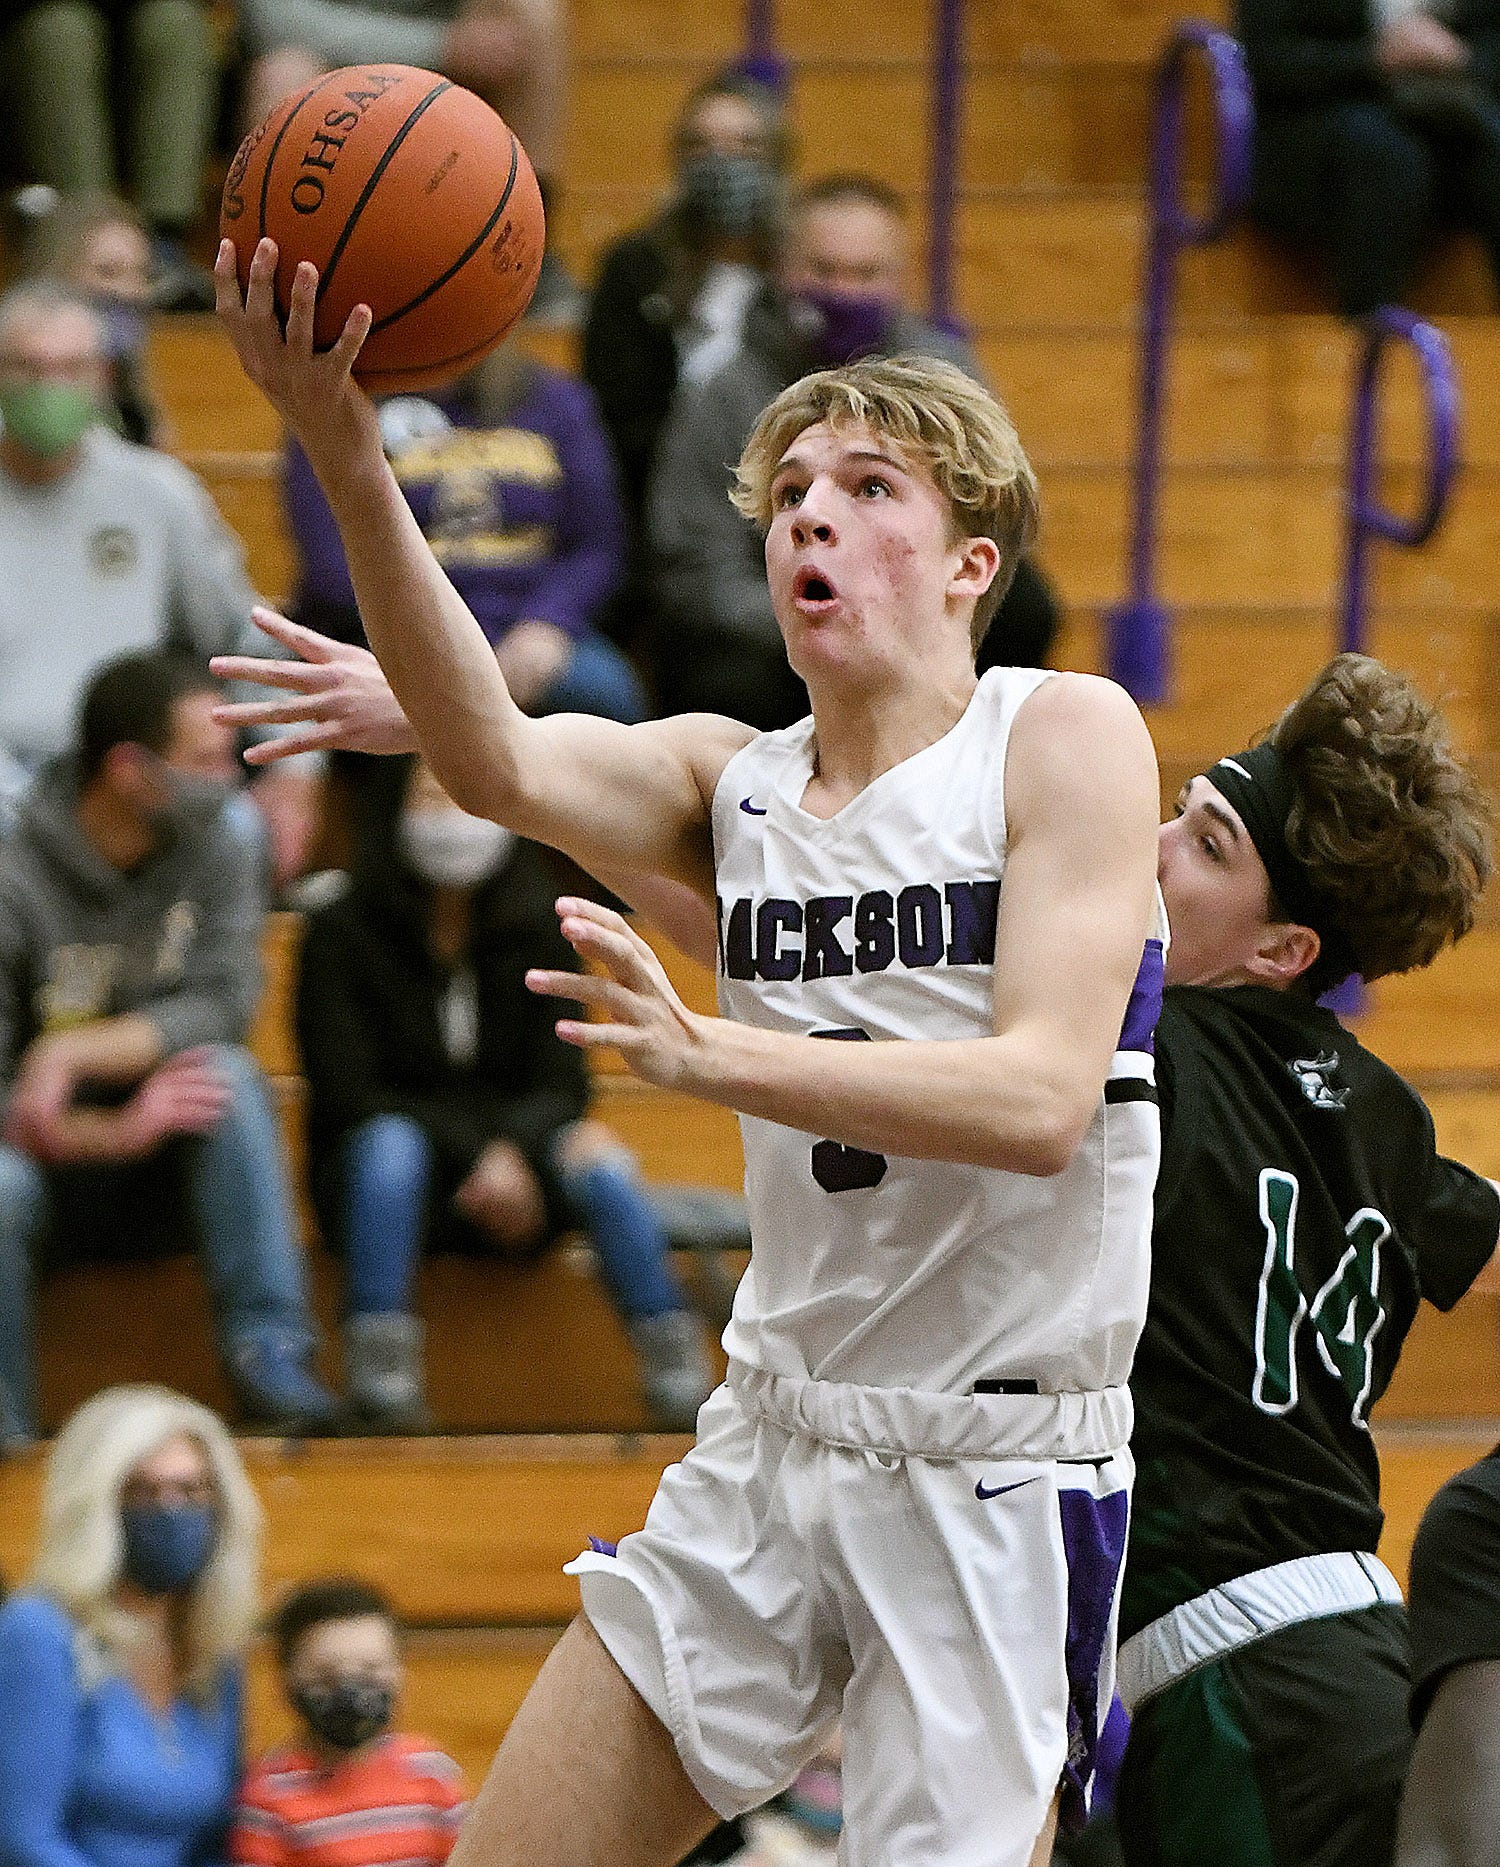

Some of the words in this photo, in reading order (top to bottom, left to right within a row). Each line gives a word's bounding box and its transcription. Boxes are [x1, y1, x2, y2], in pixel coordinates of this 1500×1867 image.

[290, 74, 402, 215] OHSAA
[716, 880, 1001, 983] ACKSON
[1252, 1167, 1392, 1430] 14
